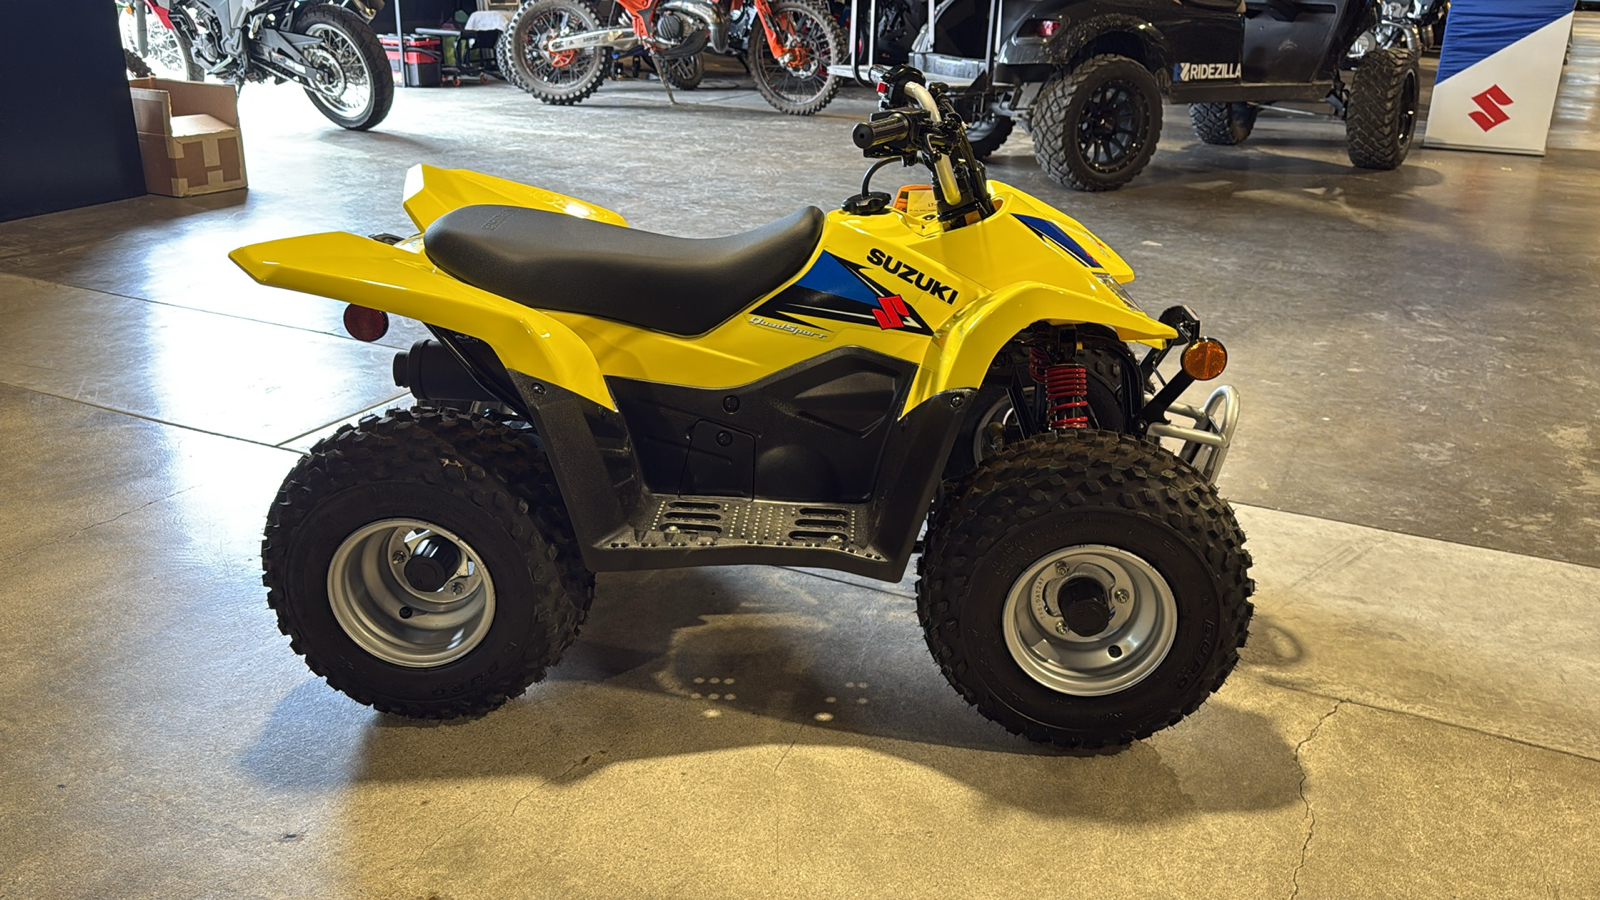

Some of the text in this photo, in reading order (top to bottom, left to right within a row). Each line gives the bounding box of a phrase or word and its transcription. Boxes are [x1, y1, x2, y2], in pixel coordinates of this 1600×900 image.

[1190, 63, 1242, 80] RIDEZILLA
[866, 248, 959, 305] SUZUKI
[749, 315, 828, 340] QuadSport
